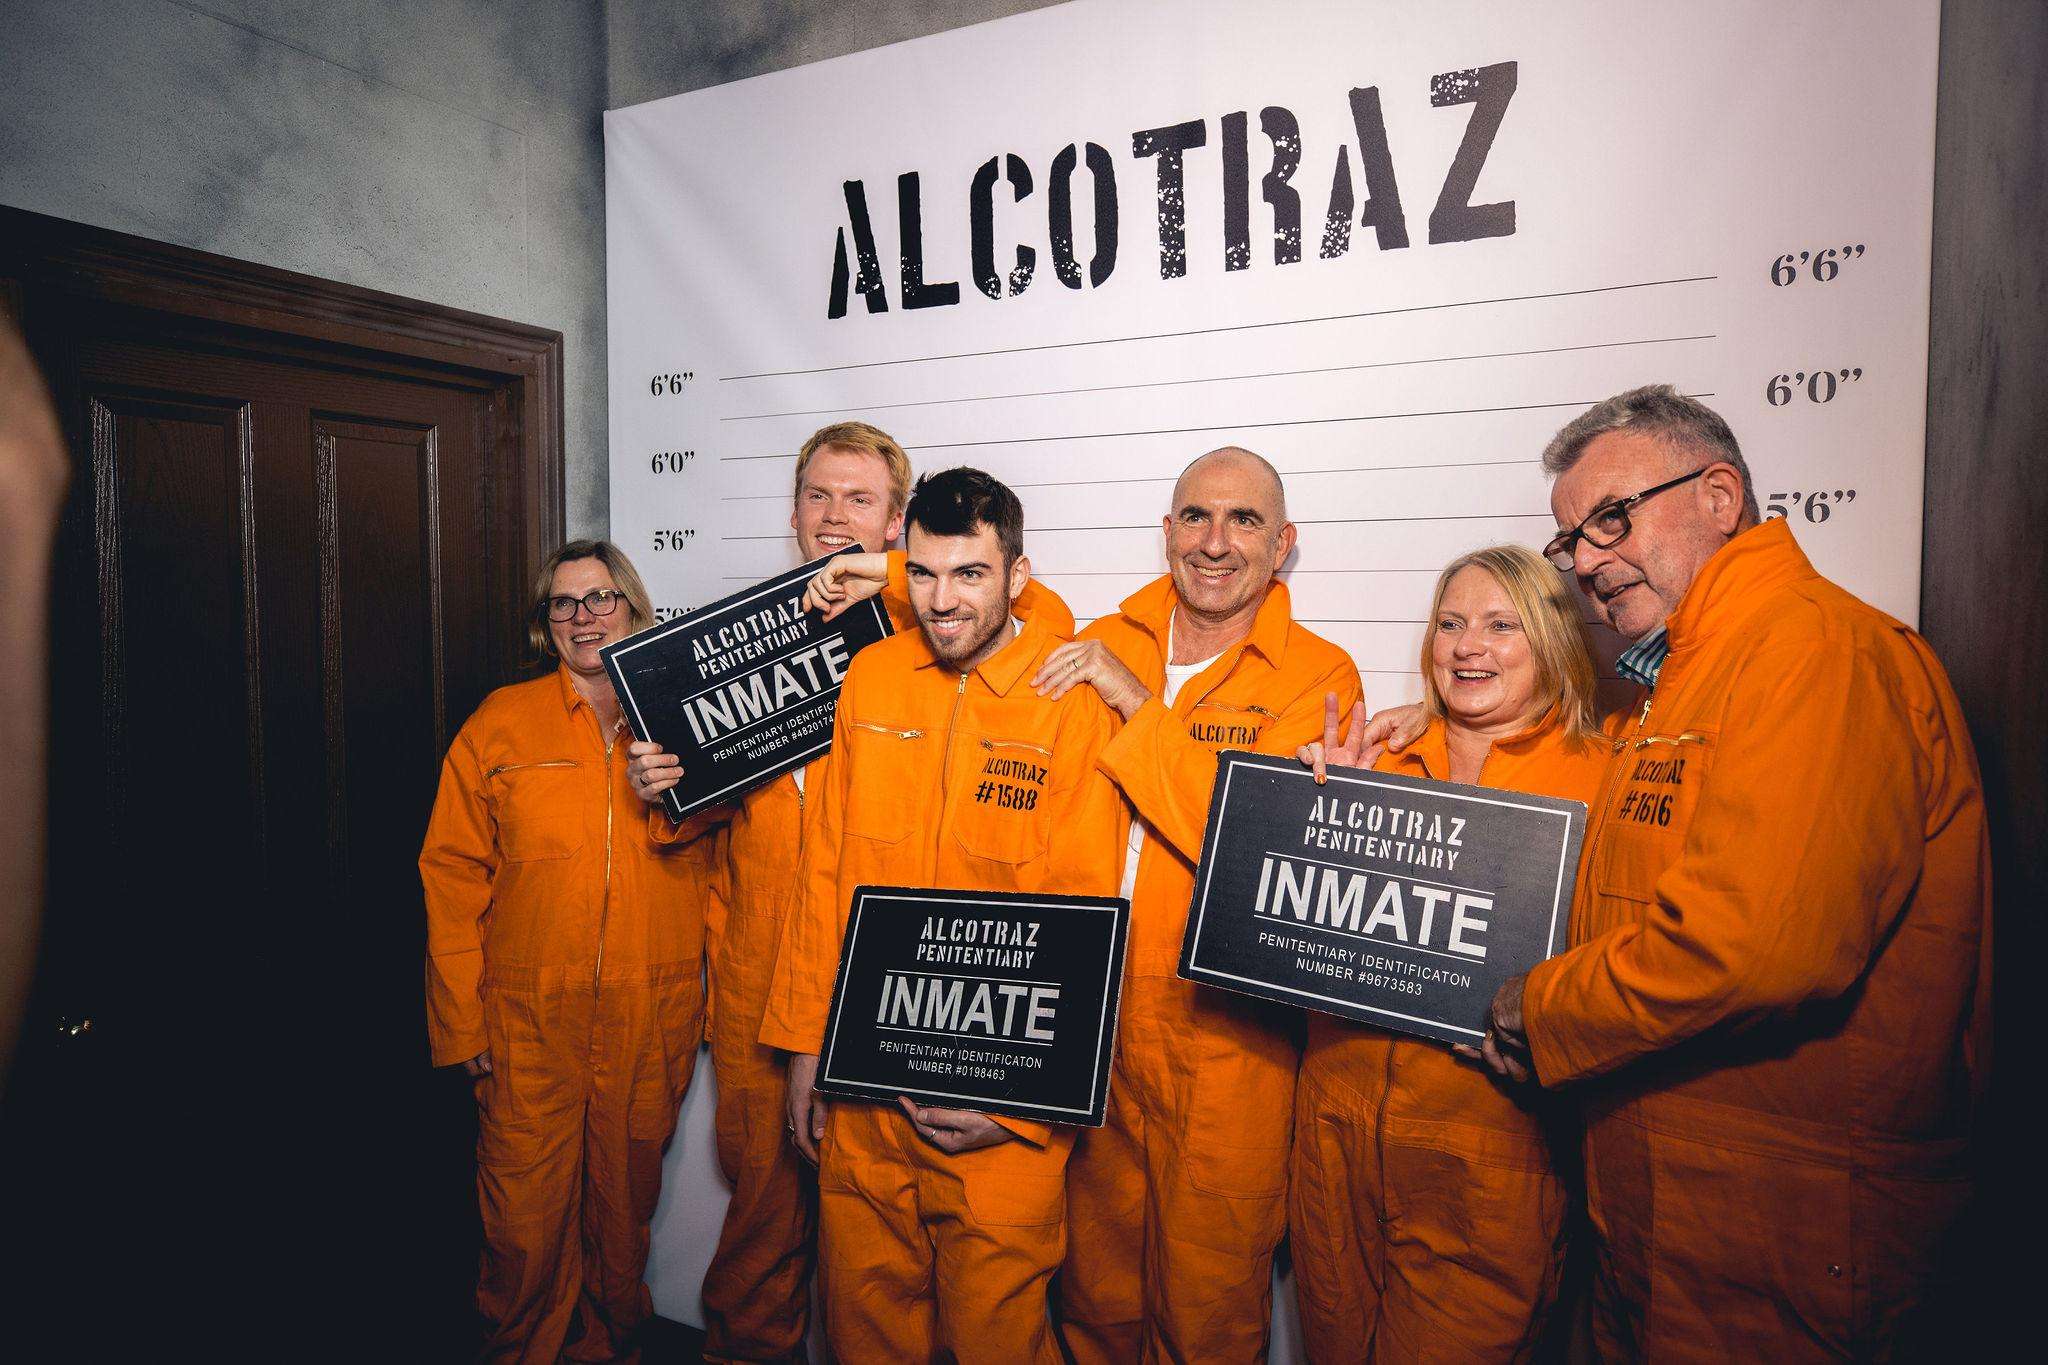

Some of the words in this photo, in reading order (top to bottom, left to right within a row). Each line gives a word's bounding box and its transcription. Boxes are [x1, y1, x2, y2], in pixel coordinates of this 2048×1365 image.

[827, 60, 1518, 319] ALCOTRAZ
[1770, 244, 1866, 287] 6'6"
[650, 371, 694, 396] 6'6"
[1766, 367, 1863, 406] 6'0"
[651, 450, 695, 474] 6'0"
[653, 529, 695, 551] 5'6"
[691, 596, 805, 662] ALCOTRAZ
[698, 619, 809, 680] PENITENTIARY
[682, 636, 850, 745] INMATE
[712, 723, 784, 763] PENITENTIARY
[786, 699, 838, 730] IDENTIFICA
[747, 736, 790, 761] NUMBER
[791, 715, 834, 741] #4820174
[975, 780, 1038, 811] #1588
[1618, 790, 1674, 828] #1616
[1307, 795, 1467, 847] ALCOTRAZ
[1303, 826, 1461, 872] PENITENTIARY
[1254, 856, 1494, 959] INMATE
[920, 916, 1041, 948] ALCOTRAZ
[916, 943, 1035, 970] PENITENTIARY
[1258, 931, 1357, 963] PENITENTIARY
[1360, 952, 1472, 989] IDENTIFICATON
[1295, 956, 1354, 981] NUMBER
[1357, 969, 1423, 997] #9673583
[876, 974, 1060, 1041] INMATE
[878, 1040, 955, 1060] PENITENTIARY
[957, 1048, 1042, 1070] IDENTIFICATON
[907, 1059, 953, 1075] NUMBER
[955, 1065, 1006, 1082] #0198463
